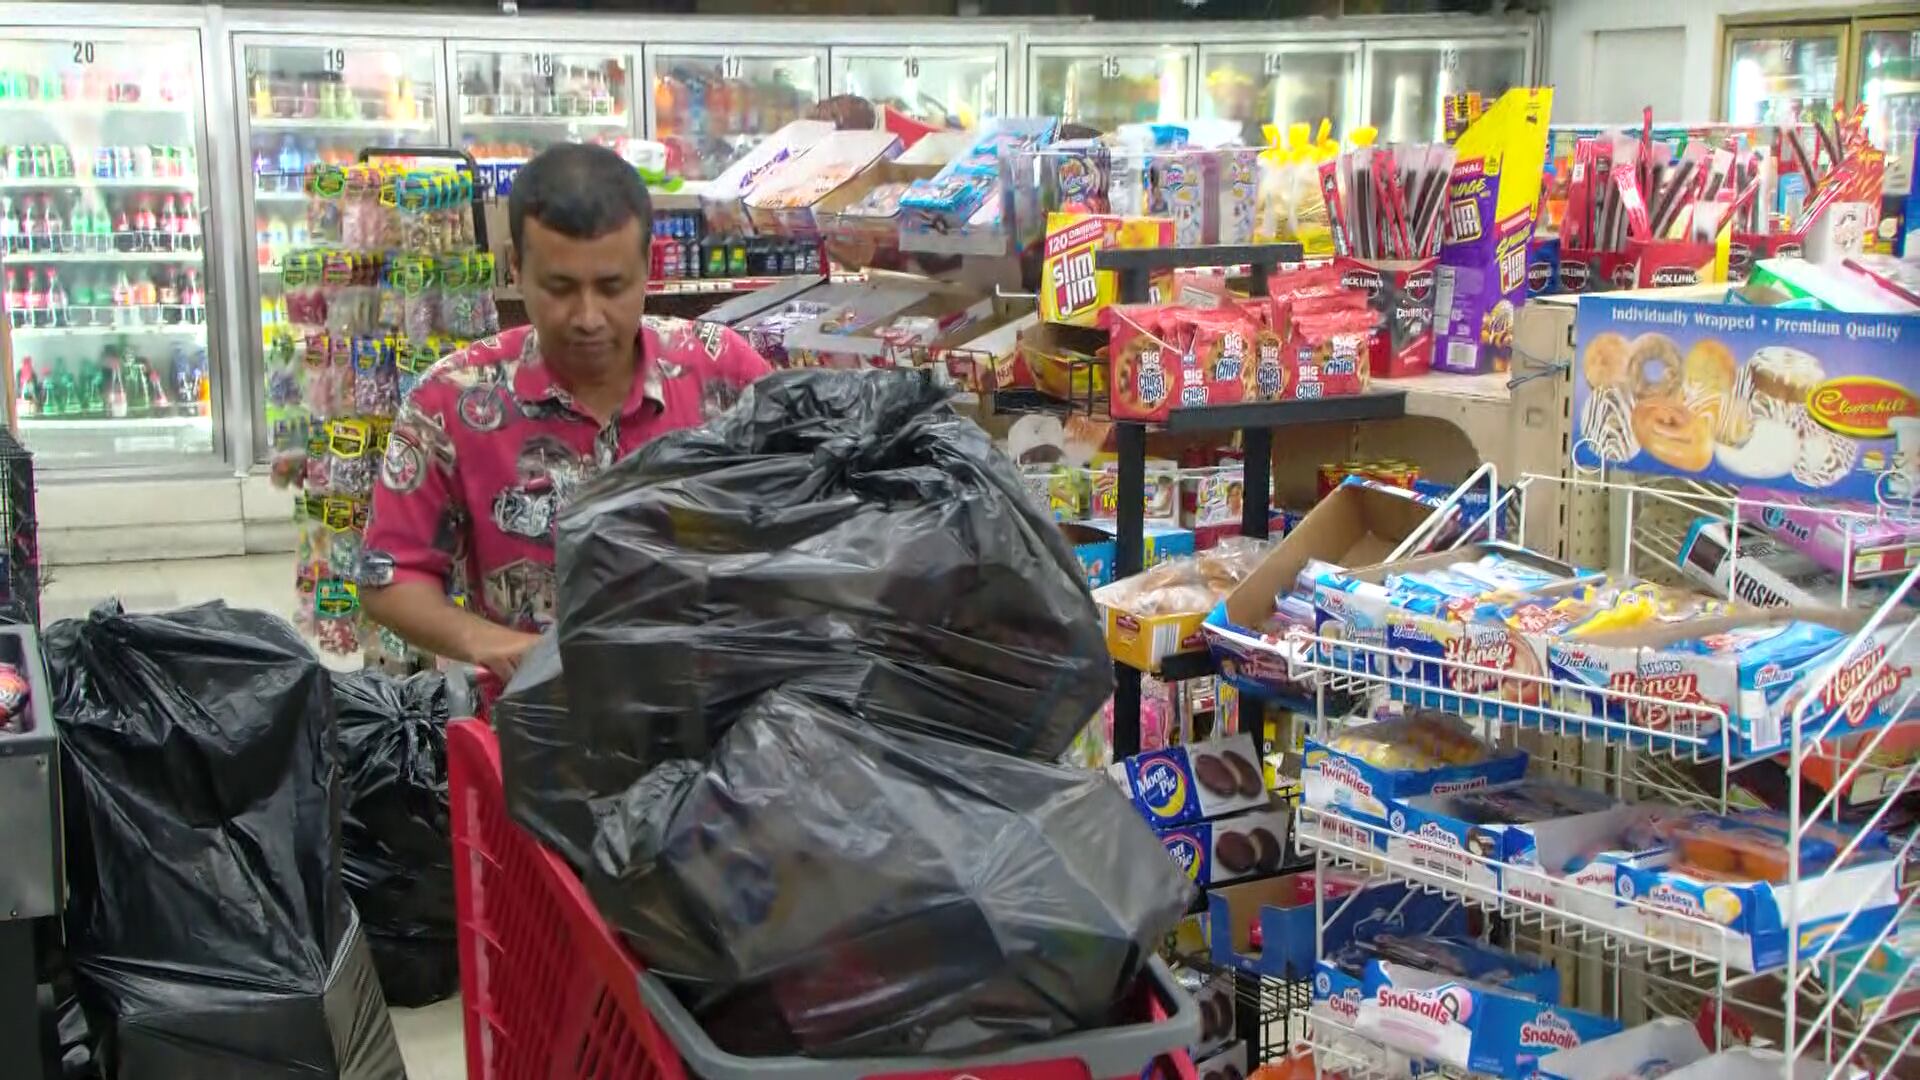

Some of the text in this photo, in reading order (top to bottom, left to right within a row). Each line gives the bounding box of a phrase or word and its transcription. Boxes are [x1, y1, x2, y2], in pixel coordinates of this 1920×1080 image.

[73, 40, 95, 64] 20
[327, 48, 345, 72] 19
[1265, 53, 1281, 74] 14
[534, 53, 551, 76] 18
[725, 56, 741, 77] 17
[903, 57, 920, 79] 16
[1105, 56, 1121, 77] 15
[1048, 233, 1069, 256] 120
[1612, 307, 1901, 343] Individually Wrapped Premium Quality
[1223, 332, 1242, 350] BIG
[1141, 351, 1160, 364] BIG
[1557, 651, 1609, 674] Duchess
[1611, 671, 1696, 704] Honey
[1825, 646, 1885, 708] Honey
[1136, 766, 1168, 796] Moon
[1159, 776, 1177, 798] Pie
[1319, 761, 1371, 797] Twinkies
[1423, 825, 1457, 845] Hostess
